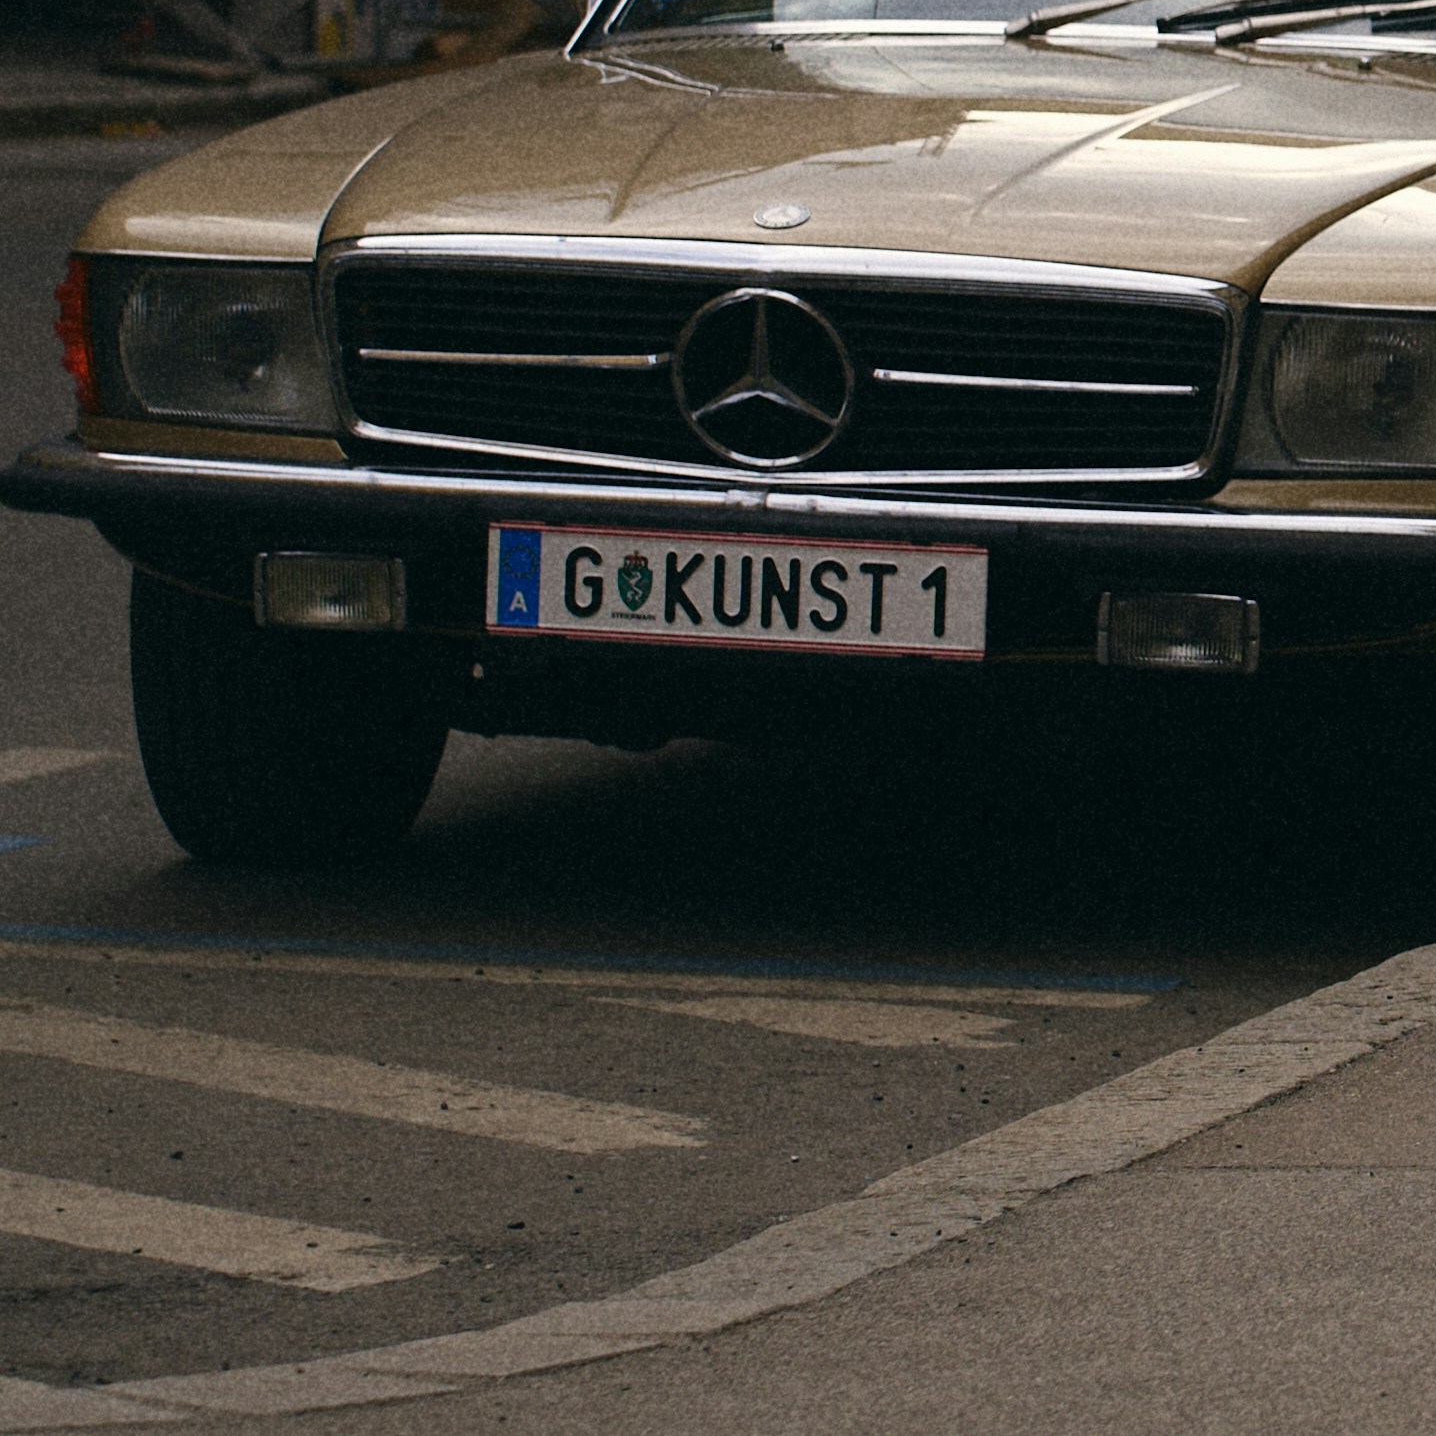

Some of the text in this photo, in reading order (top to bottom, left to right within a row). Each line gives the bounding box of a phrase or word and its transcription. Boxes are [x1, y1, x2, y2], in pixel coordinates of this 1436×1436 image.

[510, 592, 527, 613] A
[564, 546, 947, 637] G KUNST 1
